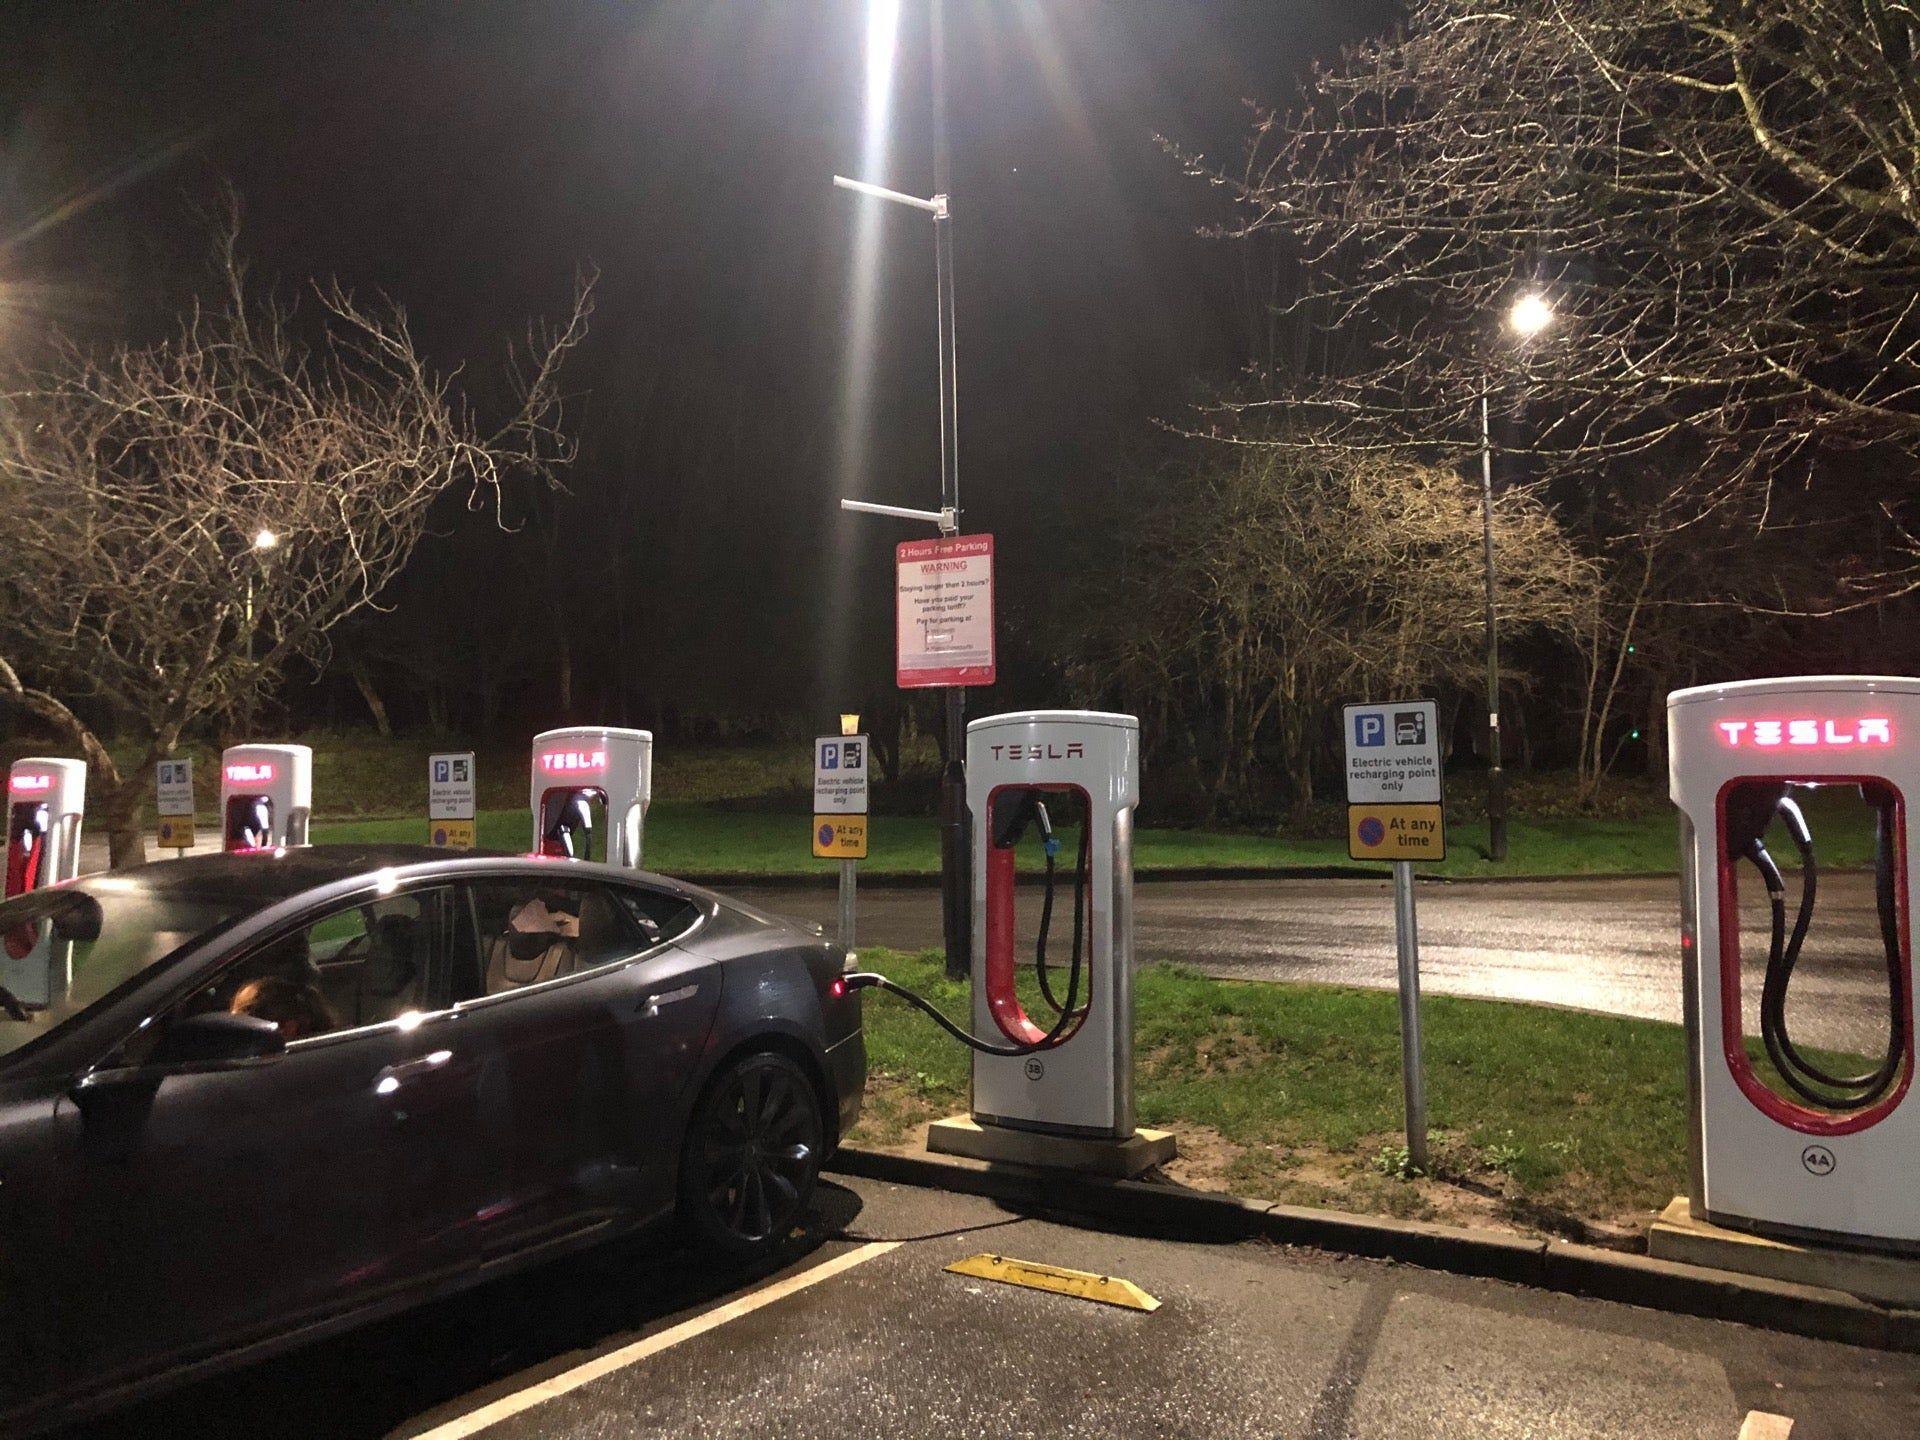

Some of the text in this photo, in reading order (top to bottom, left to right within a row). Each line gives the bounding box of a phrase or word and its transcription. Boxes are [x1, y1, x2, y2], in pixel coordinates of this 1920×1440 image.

[901, 542, 988, 557] 2 Hours Free Parking
[921, 561, 967, 572] WARNING
[959, 594, 974, 602] your
[922, 605, 946, 613] parking
[916, 617, 928, 625] Pay
[939, 616, 964, 624] parking
[1361, 717, 1380, 744] P
[1719, 718, 1889, 745] TESLA
[825, 746, 836, 767] P
[990, 743, 1083, 760] TESLA
[543, 752, 605, 769] TESLA
[1352, 755, 1432, 768] Electric vehicle
[438, 763, 447, 780] P
[1350, 768, 1436, 780] recharging point
[842, 776, 864, 784] vehicle
[1381, 781, 1404, 791] only
[816, 787, 847, 795] recharging
[833, 796, 847, 805] only
[836, 825, 863, 836] At any
[1389, 817, 1436, 833] At any
[840, 837, 859, 847] time
[1398, 831, 1430, 847] time
[1807, 1153, 1830, 1167] 4A
